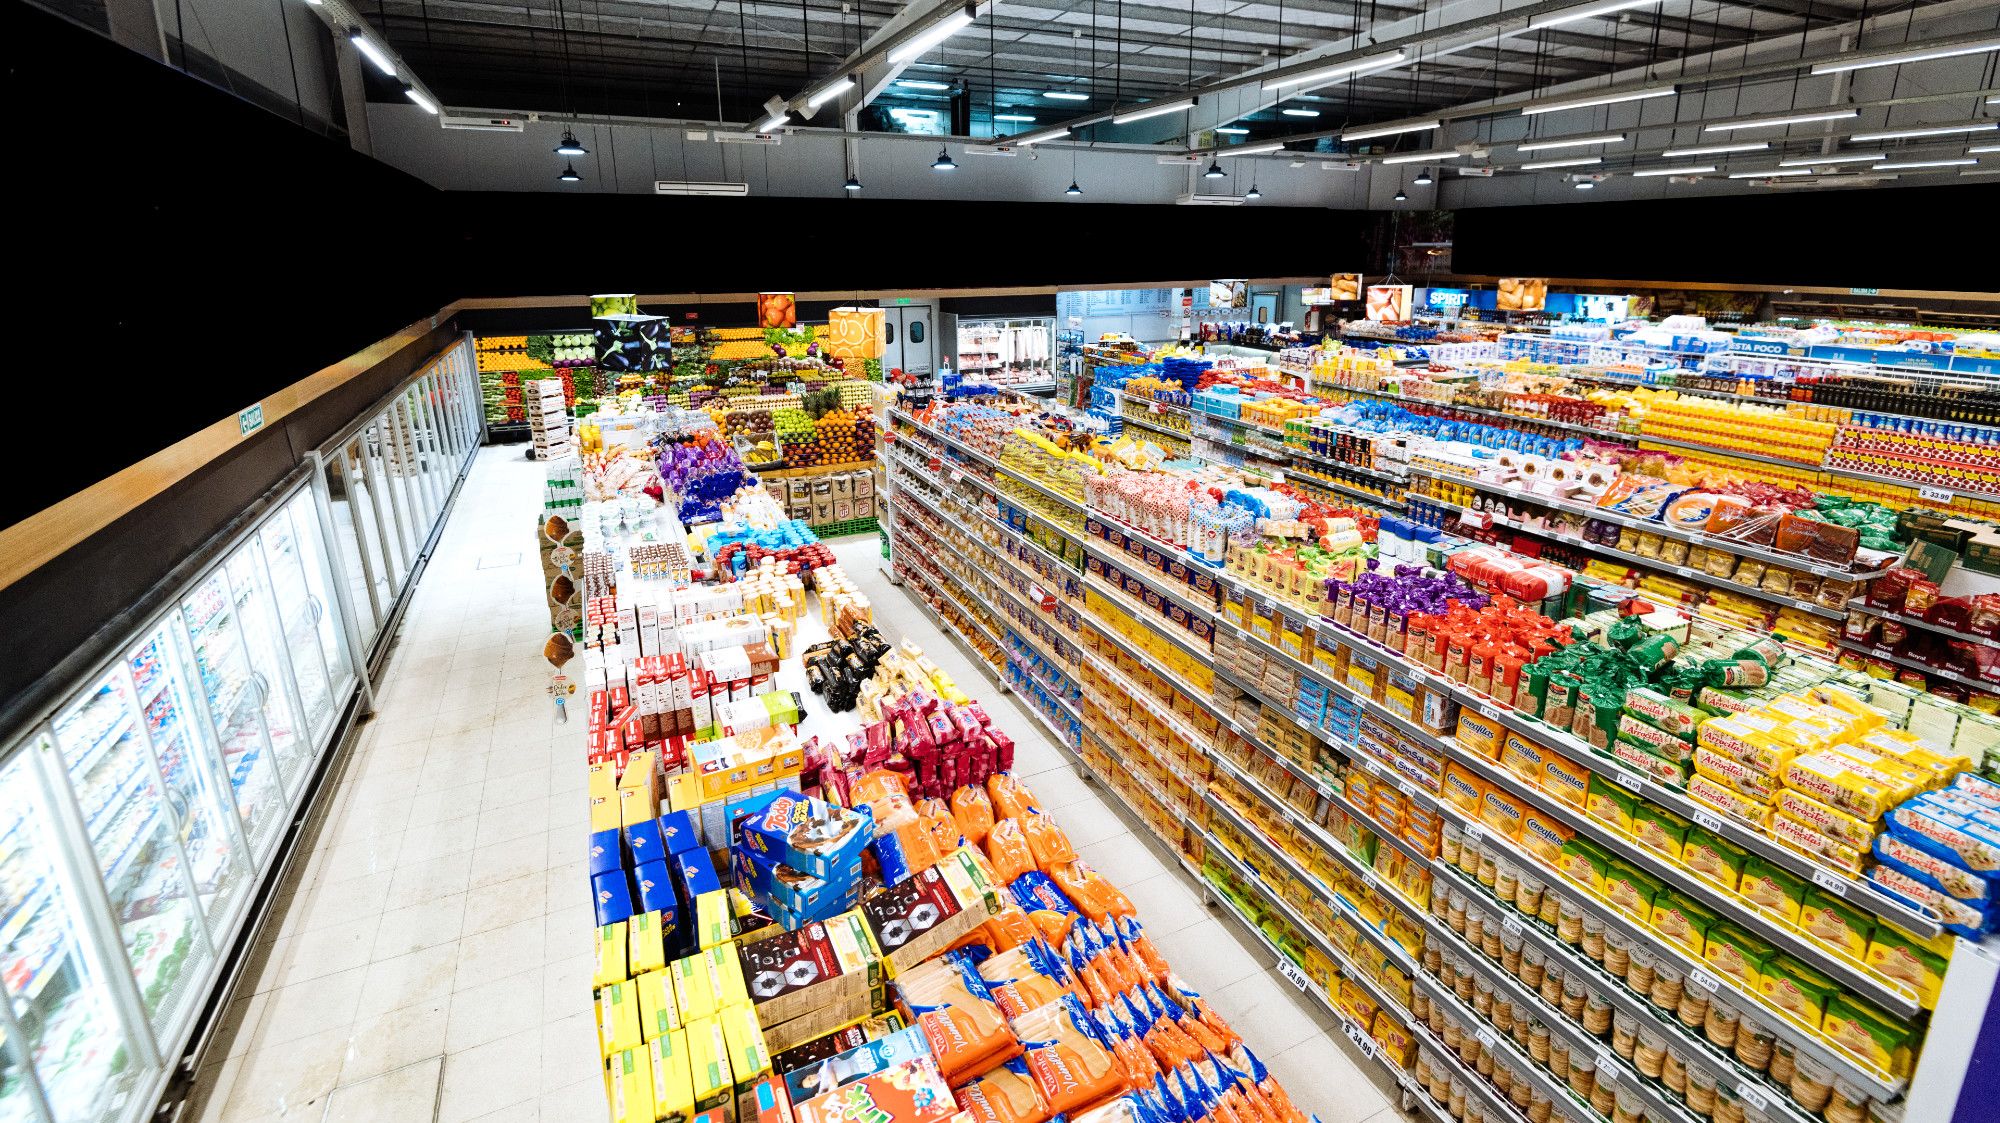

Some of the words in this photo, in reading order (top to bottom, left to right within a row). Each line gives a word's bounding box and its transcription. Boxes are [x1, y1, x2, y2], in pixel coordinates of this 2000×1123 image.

[1430, 292, 1469, 305] SPIRIT
[1754, 344, 1782, 354] POCO
[1930, 492, 1949, 501] 33.99
[1628, 699, 1665, 717] Arrocitas
[1708, 697, 1746, 713] Arrocitas
[1361, 719, 1383, 739] SinSal
[1626, 725, 1664, 744] Arrocitas
[1358, 735, 1382, 755] SinSal
[1399, 744, 1424, 763] SinSal
[1704, 731, 1744, 754] Arrocitas
[1615, 747, 1650, 766] Arrocitas
[1702, 754, 1743, 777] Arrocitas
[1397, 761, 1424, 784] SinSal
[1789, 771, 1836, 796] Arrocitas
[1693, 783, 1732, 809] Arrocitas
[765, 798, 793, 831] Toddy
[1702, 817, 1719, 830] 44.99
[1783, 799, 1830, 825] Arrocitas
[1777, 821, 1822, 847] Arrocitas
[1908, 820, 1965, 846] Arrocitas
[1890, 849, 1947, 875] Arrocitas
[1824, 879, 1845, 893] 44.99
[1878, 875, 1931, 901] Arrocitas
[1280, 963, 1286, 971] $
[1287, 969, 1306, 988] 34.99
[928, 1017, 947, 1054] Valente
[935, 1003, 968, 1053] Vainillas
[1344, 1025, 1351, 1033] $
[1352, 1033, 1373, 1056] 34.99
[1036, 1053, 1057, 1095] Valente
[1045, 1041, 1078, 1094] Vainillas
